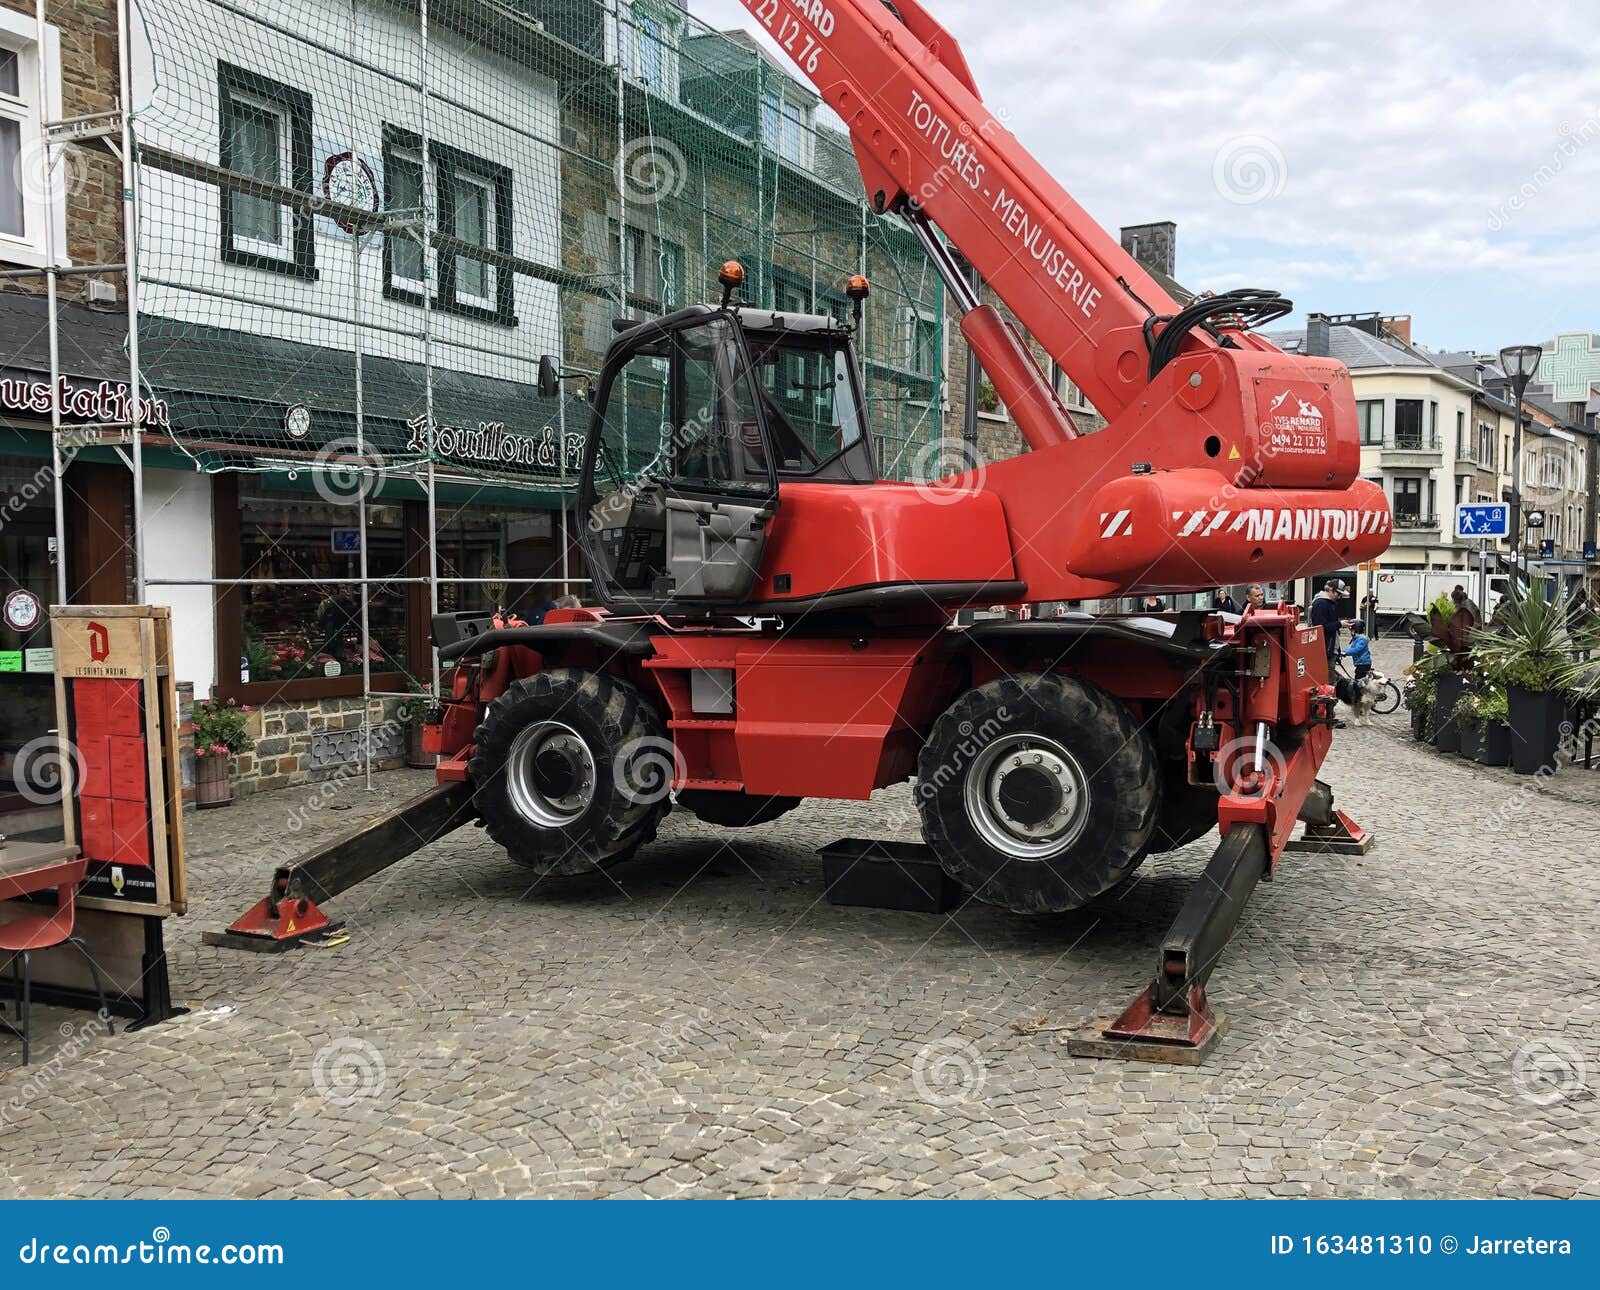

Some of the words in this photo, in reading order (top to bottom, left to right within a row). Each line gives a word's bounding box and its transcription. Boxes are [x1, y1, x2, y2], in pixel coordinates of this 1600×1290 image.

[790, 0, 835, 37] ARD
[778, 13, 800, 51] 12
[798, 34, 823, 73] 76
[907, 90, 986, 189] TOITURES
[991, 188, 1102, 319] MENUISERIE
[407, 413, 535, 465] Bouillon
[1290, 416, 1321, 427] RENARD
[1271, 433, 1291, 446] 0494
[1292, 434, 1303, 447] 22
[1305, 435, 1315, 447] 12
[1316, 436, 1326, 448] 76
[1246, 508, 1359, 541] MANITOU
